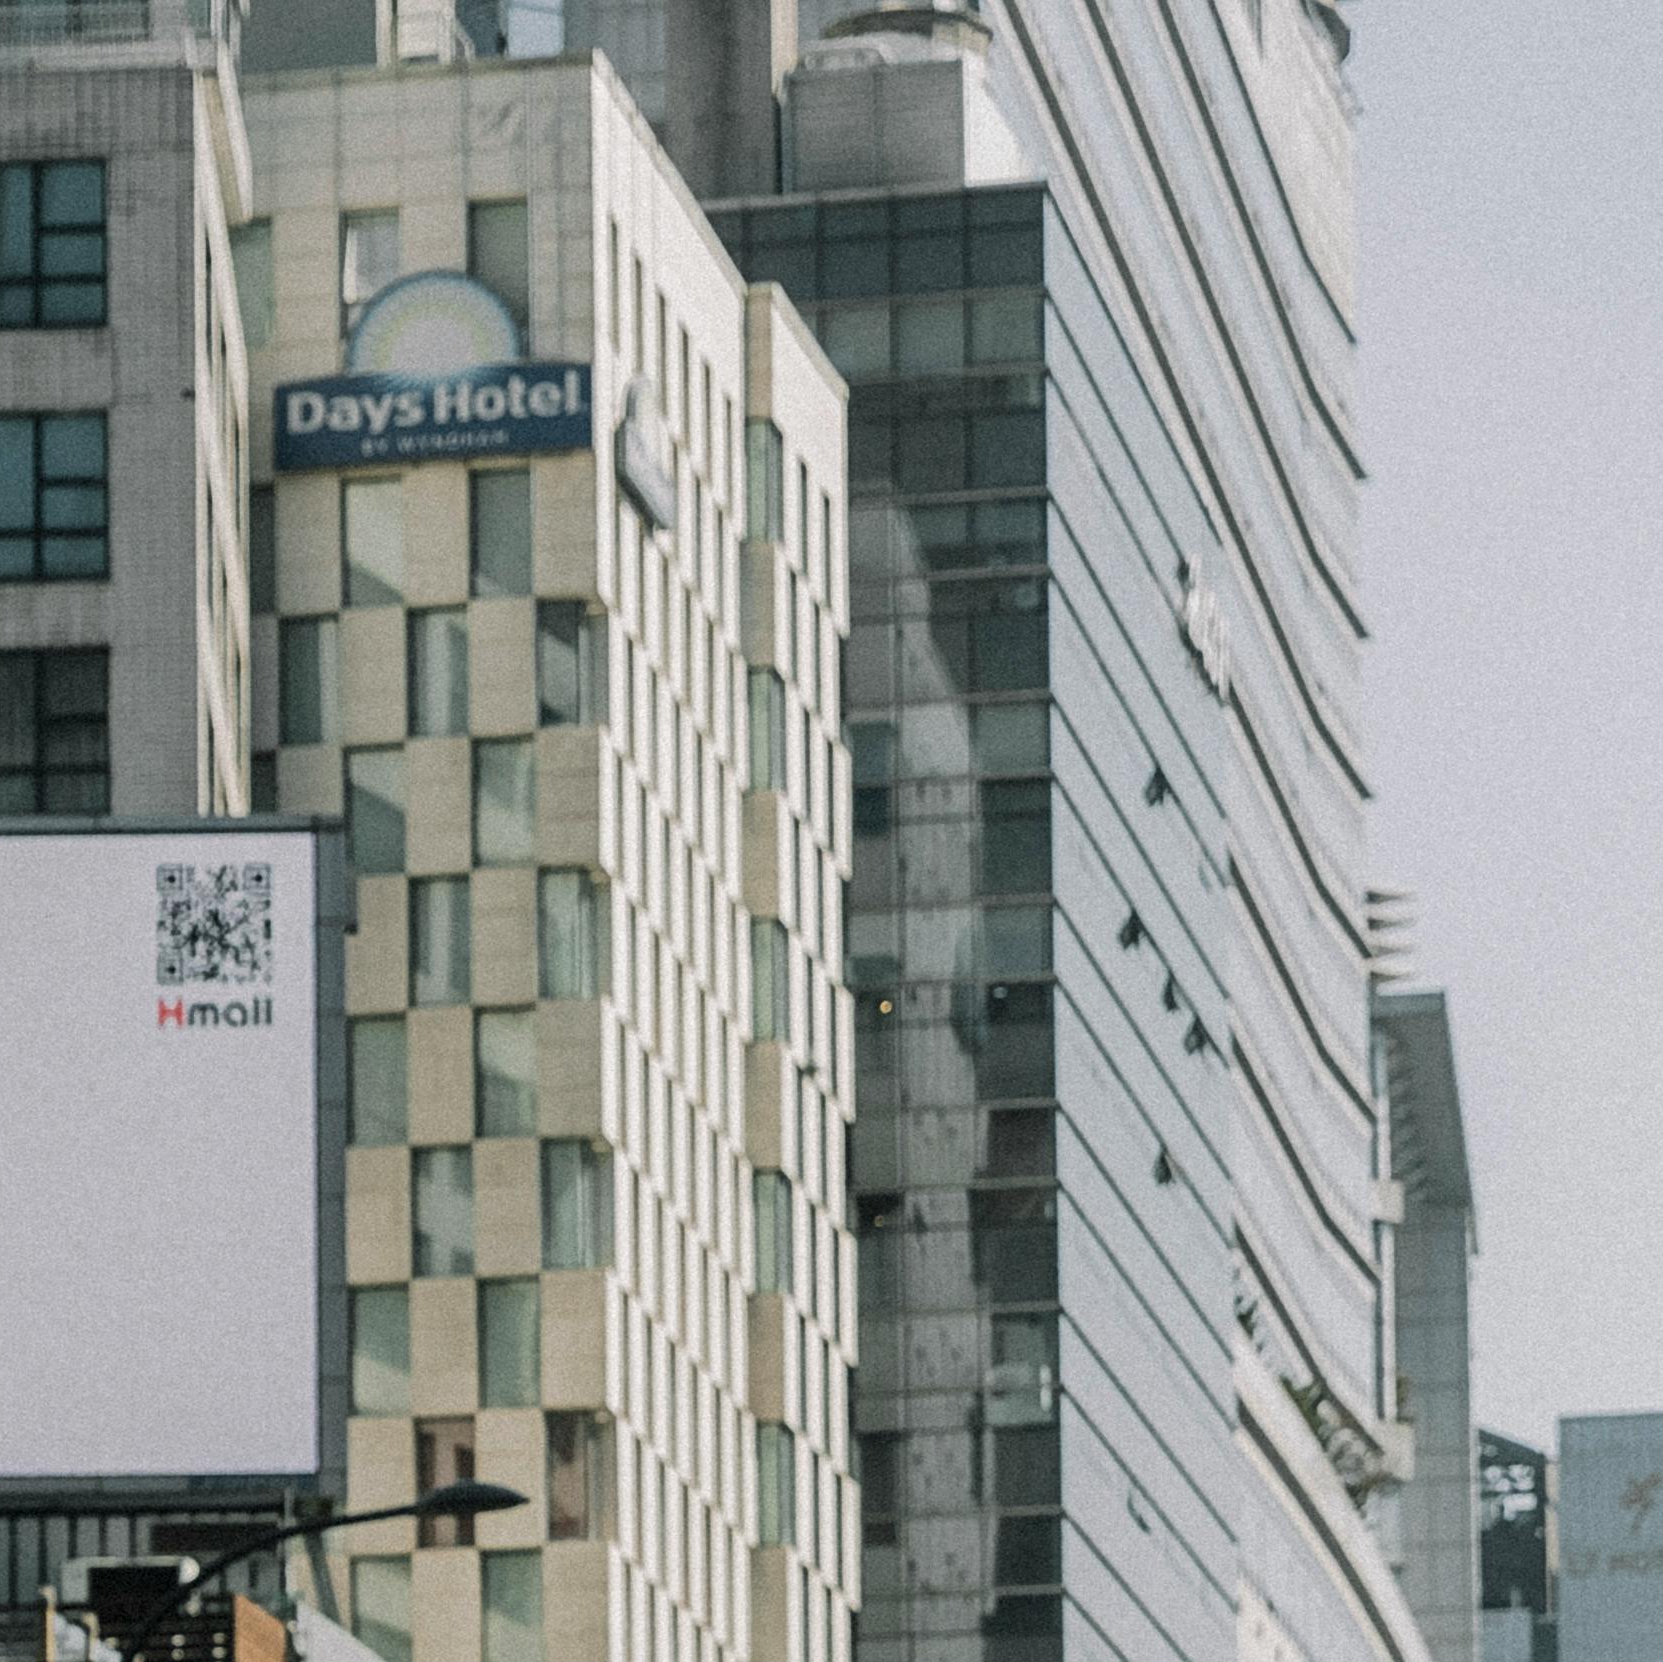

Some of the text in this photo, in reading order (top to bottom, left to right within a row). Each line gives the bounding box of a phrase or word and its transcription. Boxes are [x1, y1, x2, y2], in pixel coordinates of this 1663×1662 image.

[287, 370, 581, 434] Days Hotel
[158, 996, 272, 1027] Hmall
